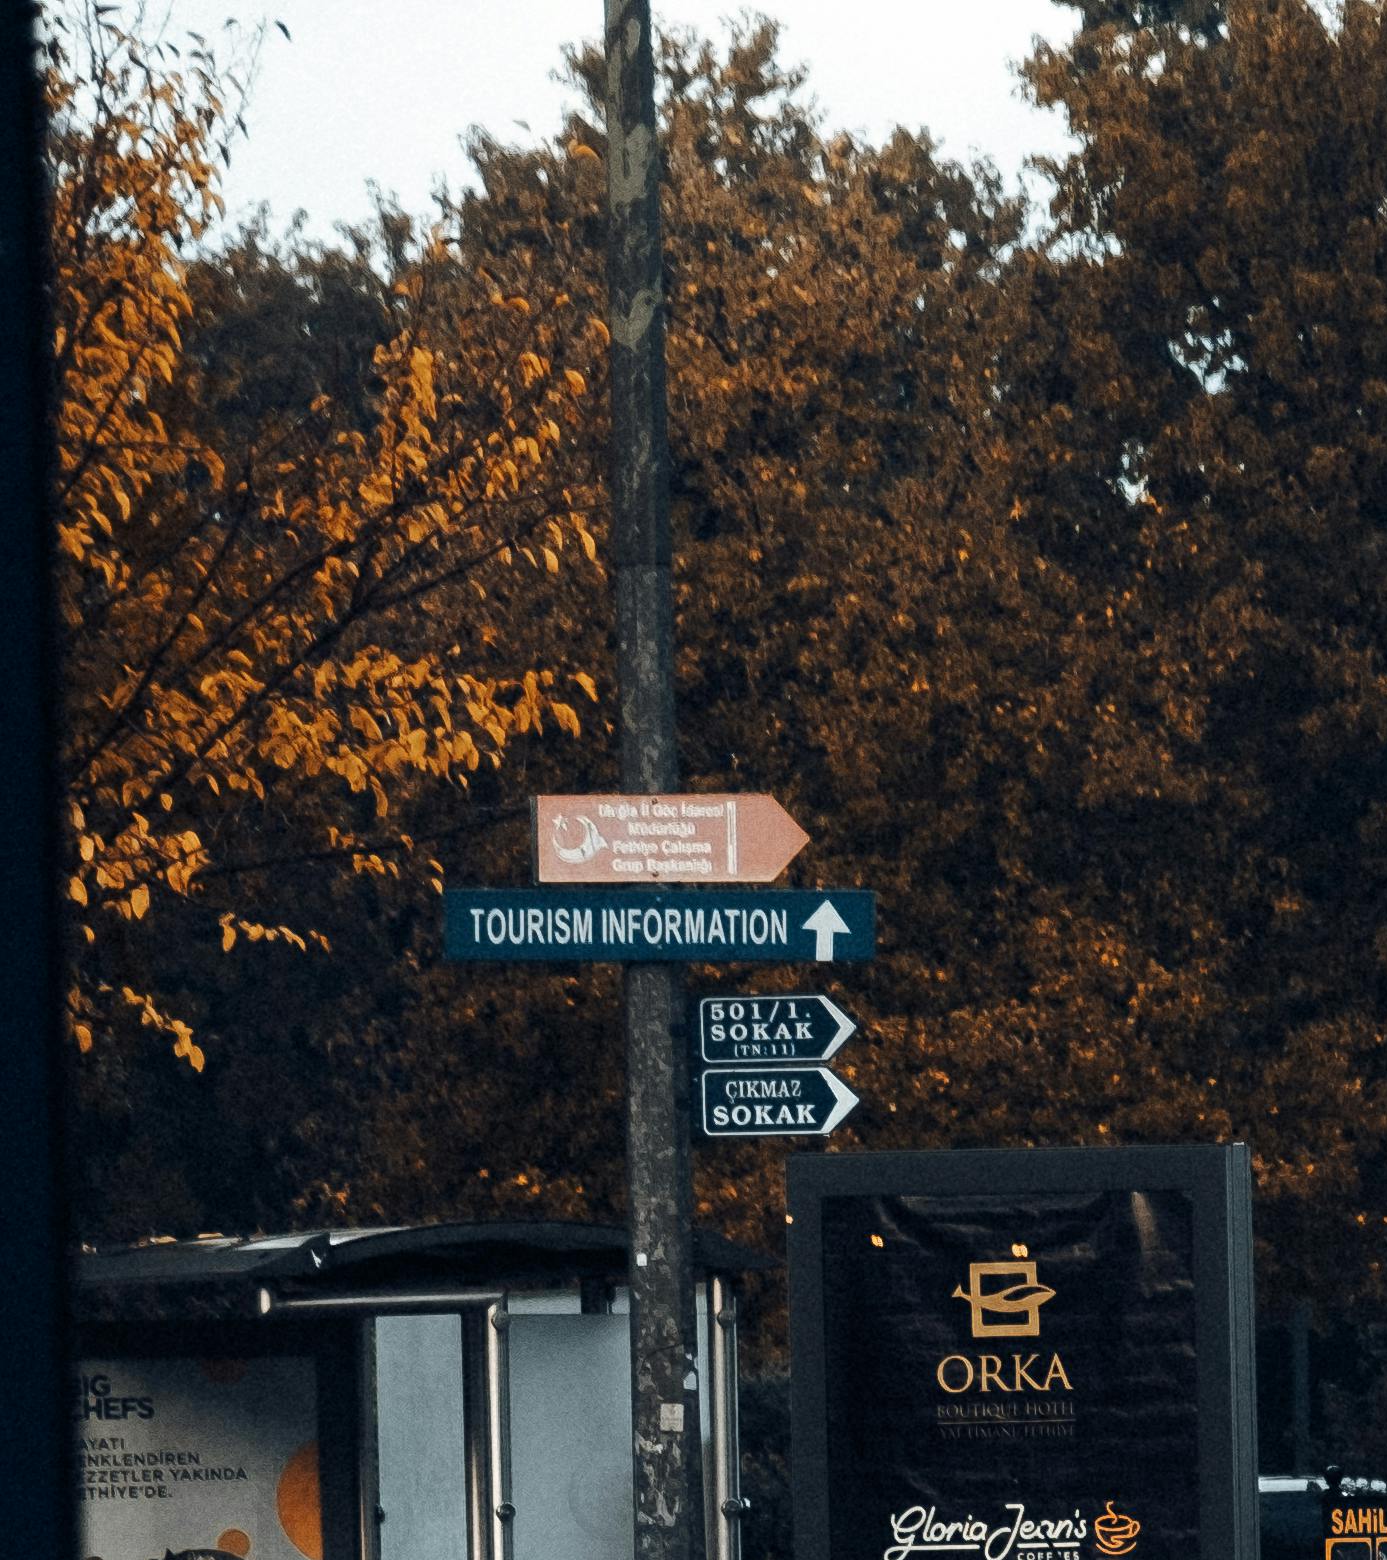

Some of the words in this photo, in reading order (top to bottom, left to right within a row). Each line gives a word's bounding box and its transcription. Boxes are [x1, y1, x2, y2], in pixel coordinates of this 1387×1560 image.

[470, 908, 593, 944] TOURISM
[602, 907, 788, 945] INFORMATION
[710, 1001, 811, 1023] 501/1.
[711, 1022, 814, 1042] SOKAK
[725, 1079, 802, 1105] ÇIKMAZ
[713, 1104, 817, 1126] SOKAK
[937, 1352, 1073, 1393] ORKA
[169, 1467, 249, 1482] YAKINDA
